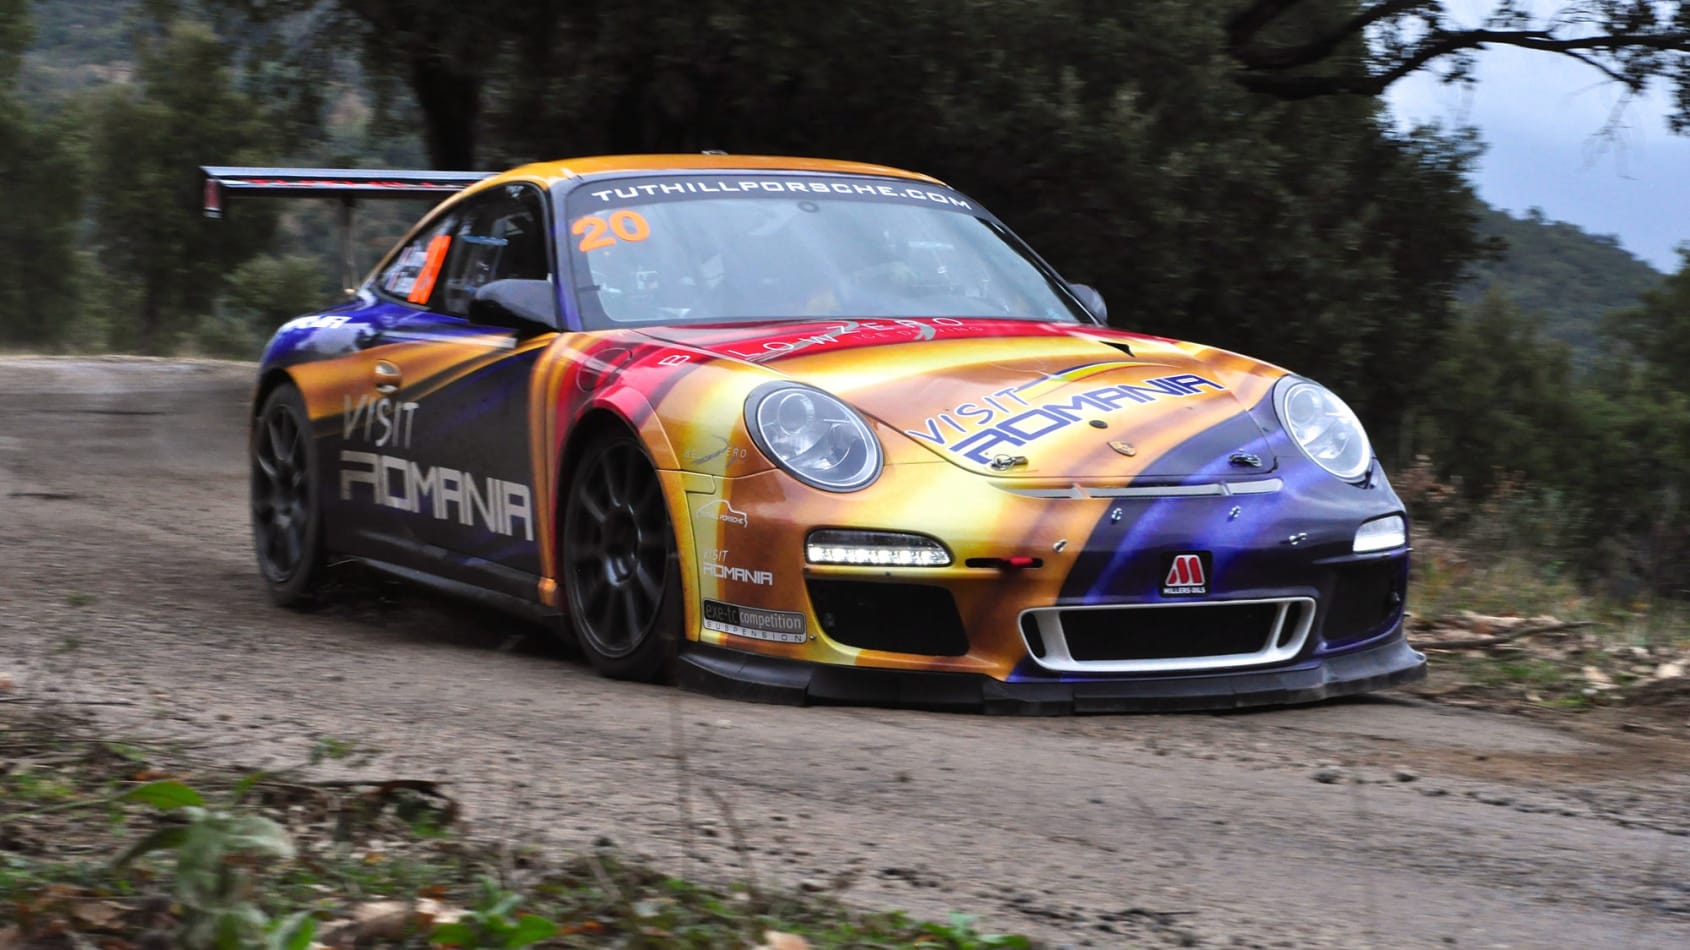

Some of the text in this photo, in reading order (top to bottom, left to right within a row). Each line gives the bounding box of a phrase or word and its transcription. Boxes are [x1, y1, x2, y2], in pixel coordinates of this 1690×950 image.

[592, 181, 971, 210] TUTHILLPORSCHE.COM
[571, 210, 650, 253] 20
[343, 395, 420, 449] VISIT
[905, 387, 1028, 446] VISIT
[949, 374, 1225, 465] ROMANIA
[340, 450, 535, 541] ROMANIA
[703, 561, 773, 586] ROMANIA
[706, 620, 802, 642] SUSPENSION
[739, 611, 802, 630] competition
